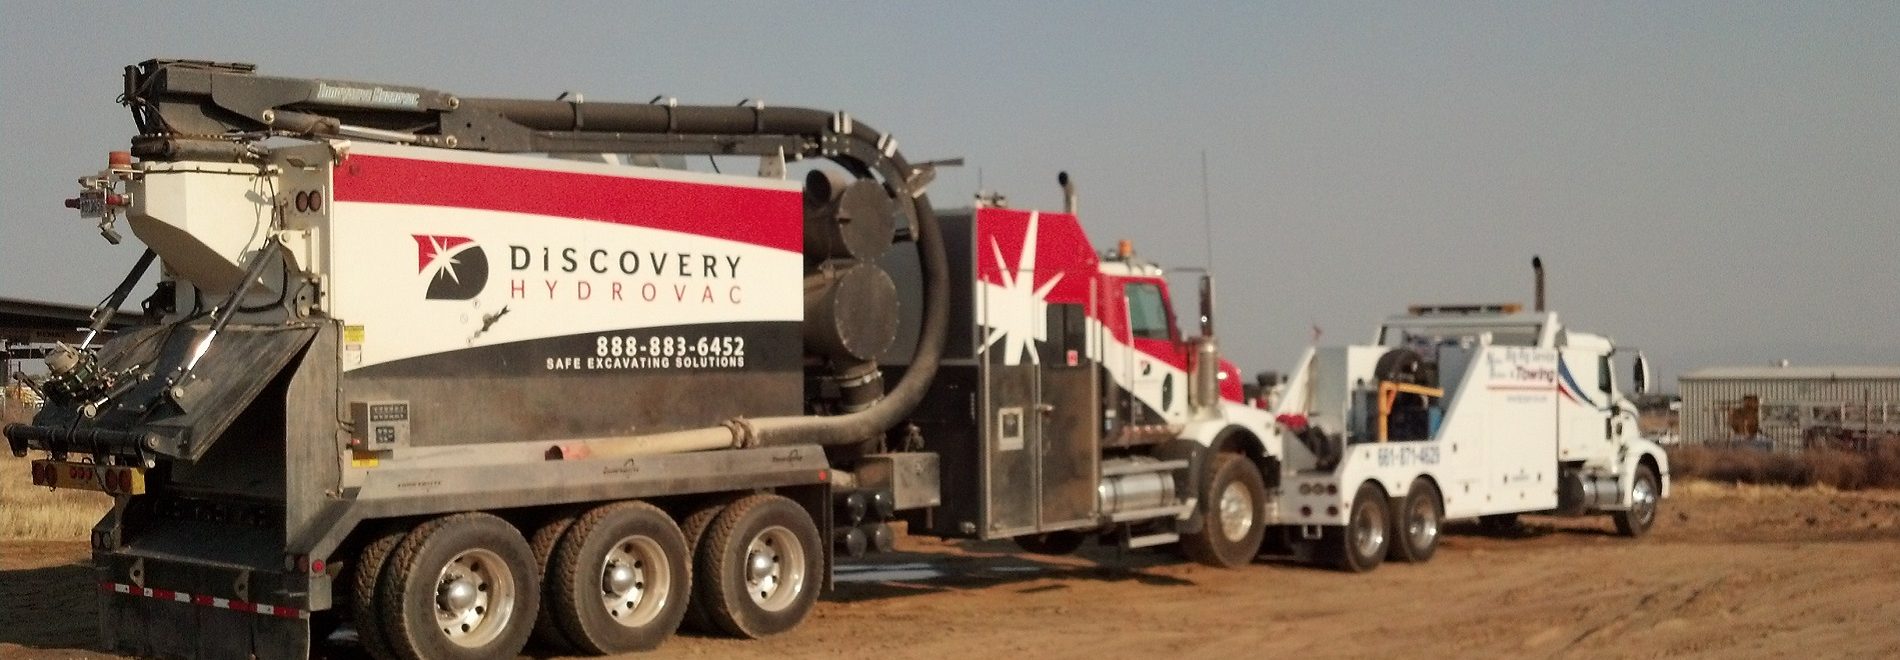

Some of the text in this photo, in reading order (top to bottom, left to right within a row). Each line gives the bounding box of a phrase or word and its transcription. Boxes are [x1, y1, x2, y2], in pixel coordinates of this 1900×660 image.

[509, 245, 742, 278] DISCOVERY
[511, 279, 741, 304] HYDROVAC
[596, 336, 744, 357] 888-883-6452
[547, 356, 744, 370] SAFE EXCAVATING SOLUTIONS
[1516, 366, 1554, 383] Towing
